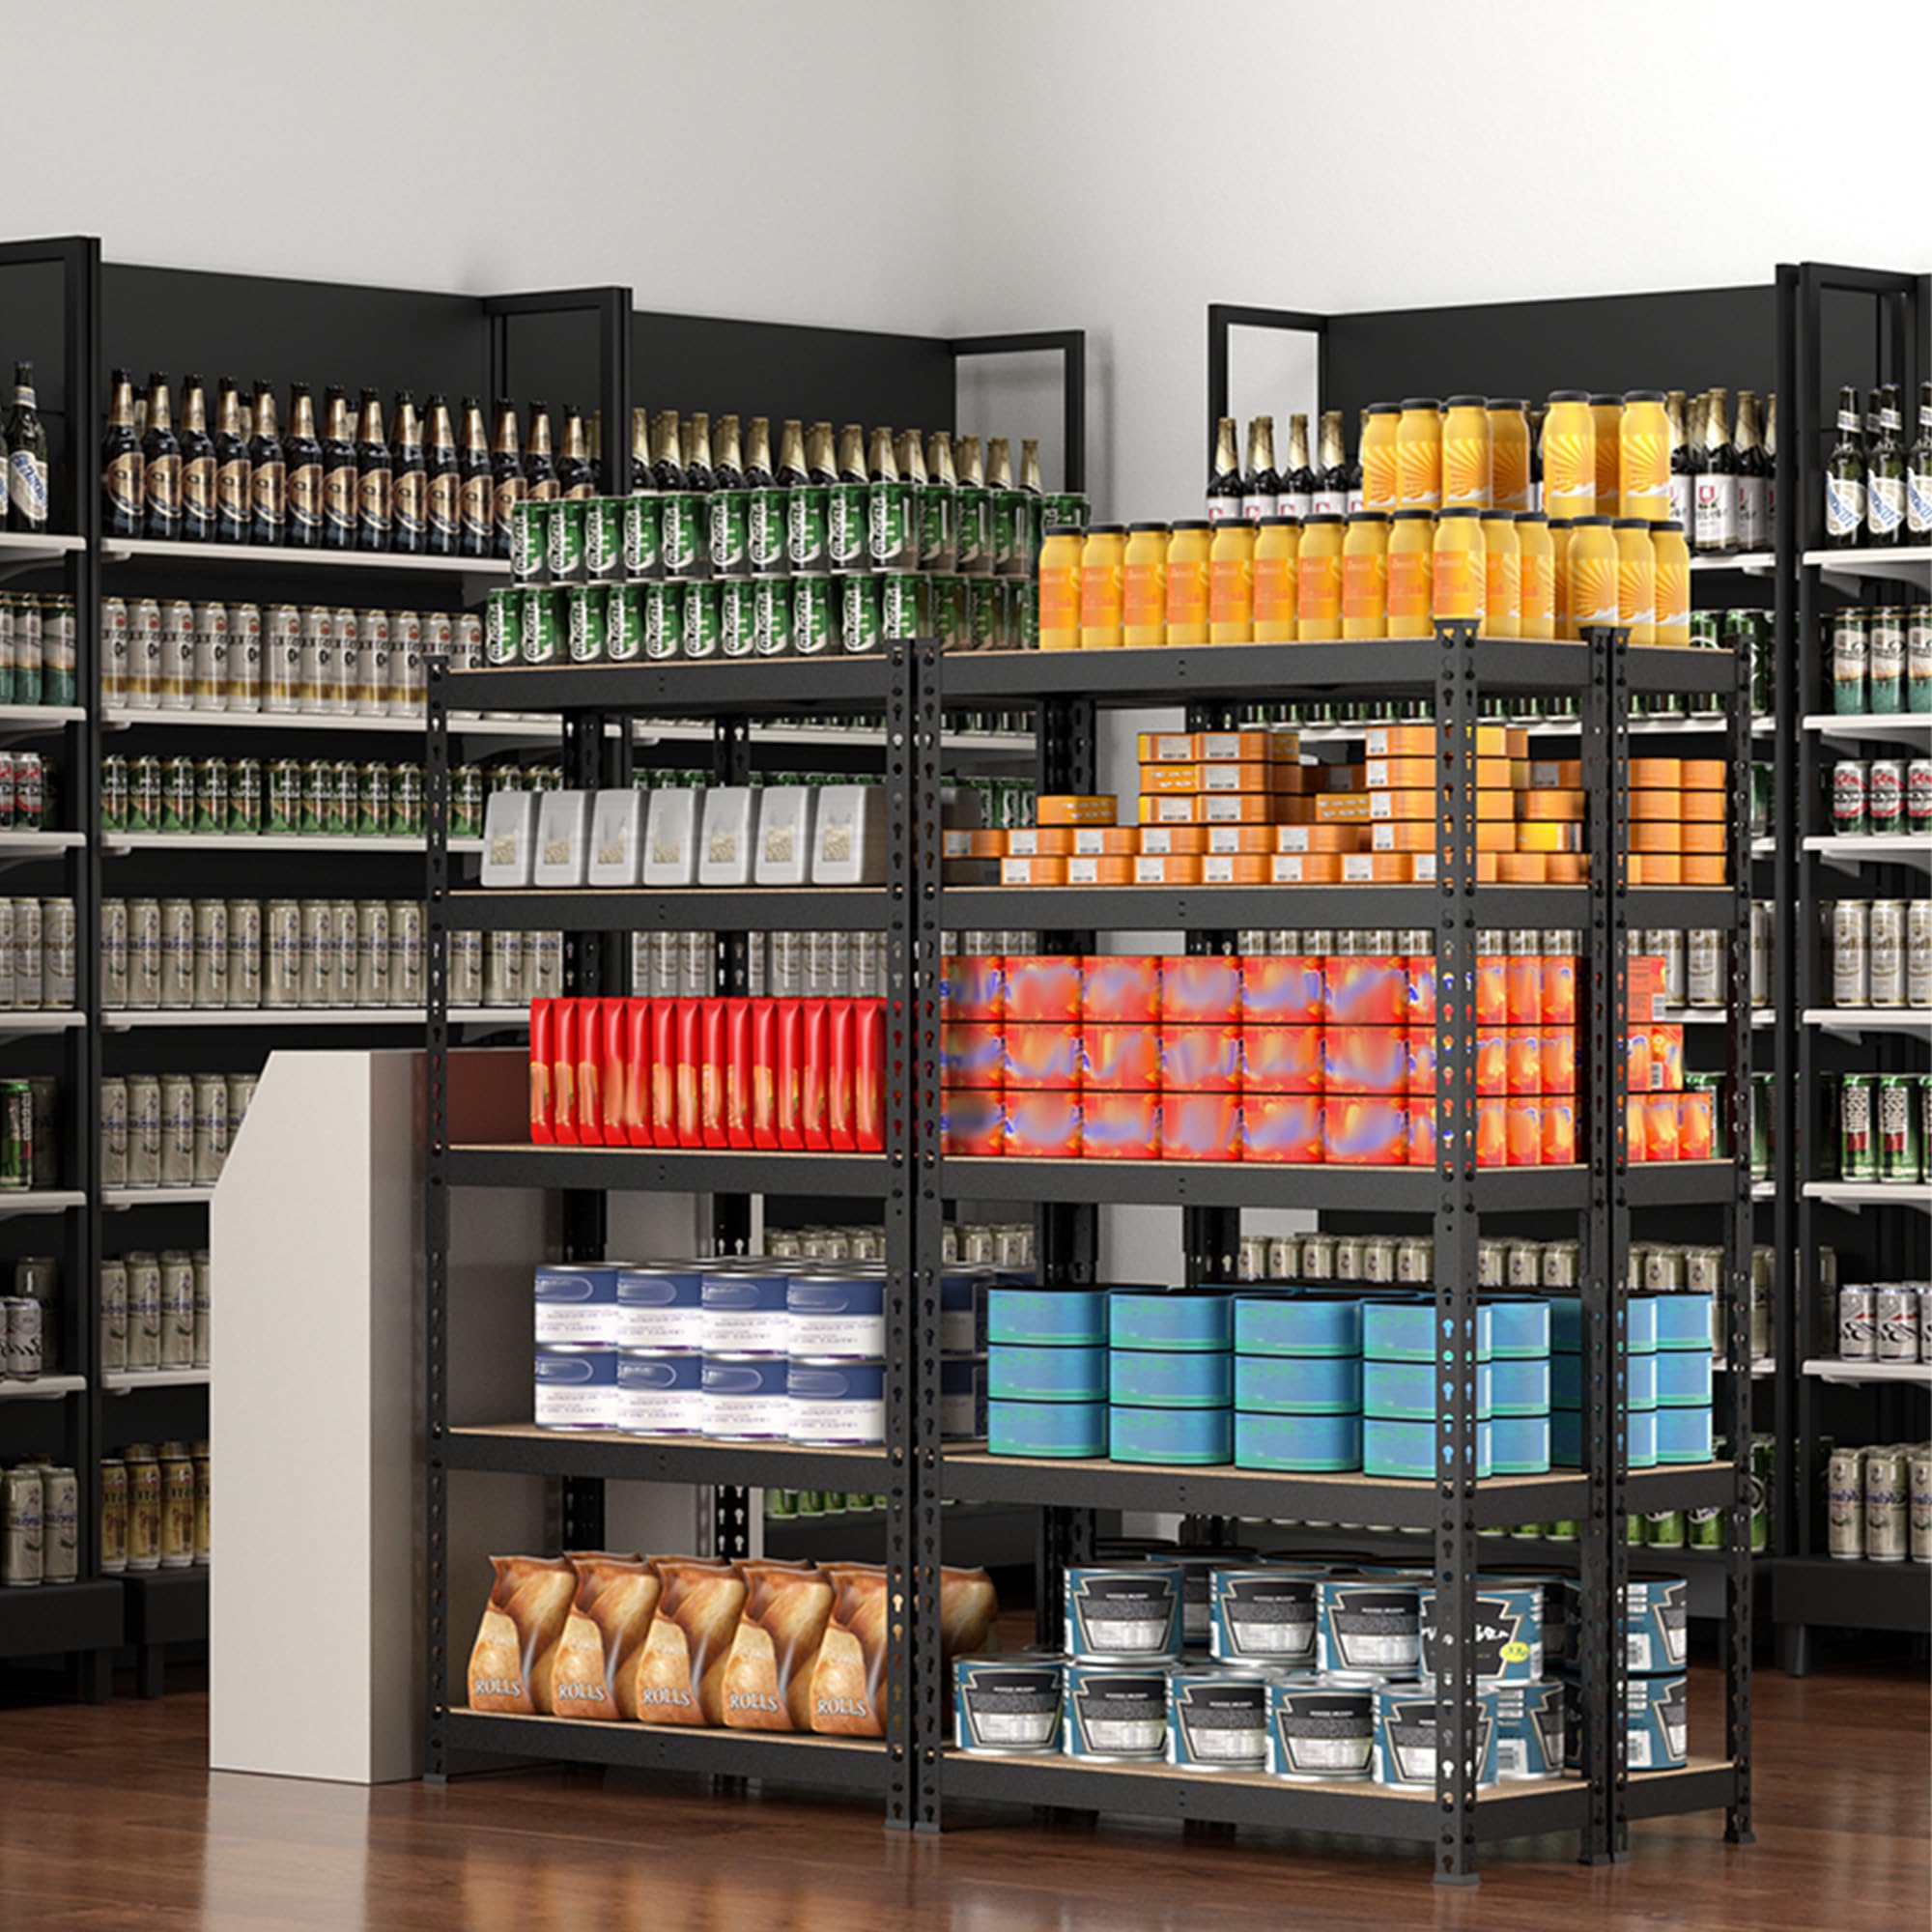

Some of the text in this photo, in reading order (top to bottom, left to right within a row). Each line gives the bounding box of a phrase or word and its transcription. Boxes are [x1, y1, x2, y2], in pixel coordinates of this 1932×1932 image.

[475, 1677, 521, 1697] ROLLS
[558, 1683, 605, 1701] ROLLS
[643, 1688, 691, 1707] ROLLS
[729, 1692, 778, 1712] ROLLS
[818, 1697, 867, 1717] ROLLS
